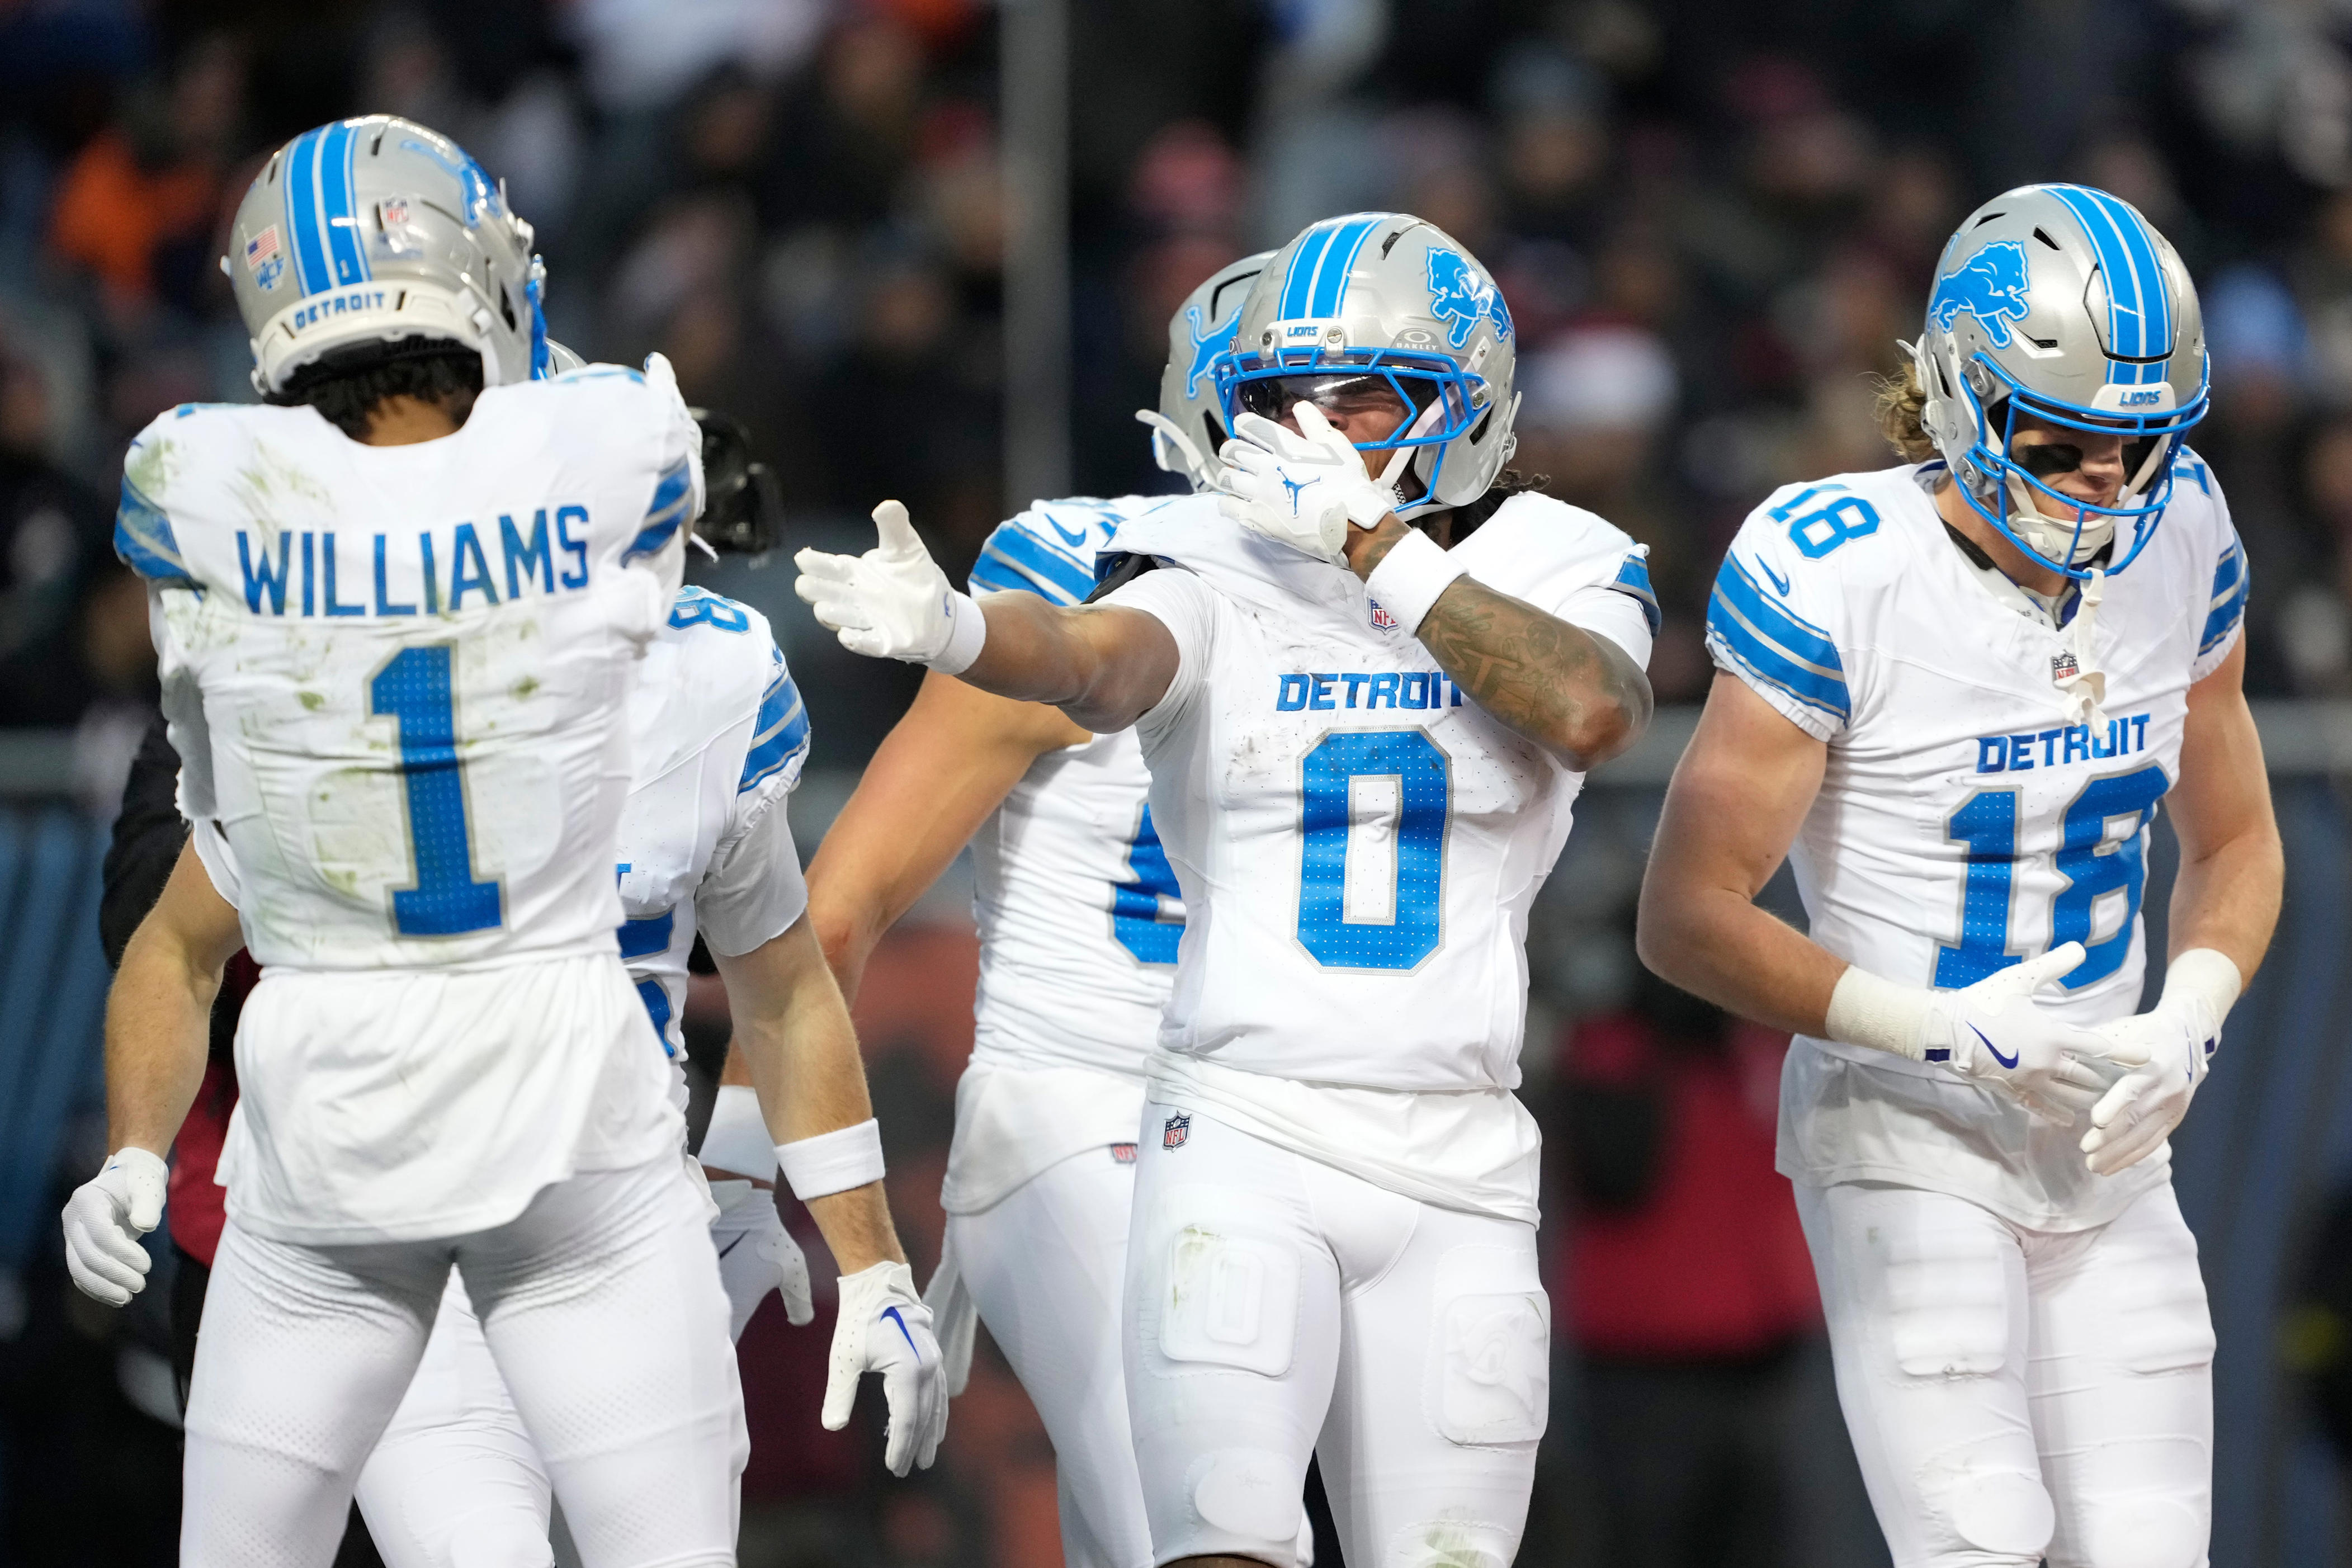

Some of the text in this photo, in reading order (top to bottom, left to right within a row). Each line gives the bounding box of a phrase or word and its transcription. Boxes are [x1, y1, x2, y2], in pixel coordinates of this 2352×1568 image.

[295, 291, 385, 329] DETROIT
[1287, 326, 1318, 336] LIONS
[1396, 342, 1437, 351] OAKLEY
[2119, 390, 2161, 406] LIONS
[1763, 484, 1883, 563] 18
[236, 504, 589, 617] WILLIAMS
[1976, 713, 2150, 773] DETROIT
[364, 641, 506, 938] 1
[1290, 724, 1453, 977] 0
[1927, 758, 2172, 998] 18
[1114, 1145, 1137, 1161] NFL
[1165, 1126, 1184, 1145] NFL
